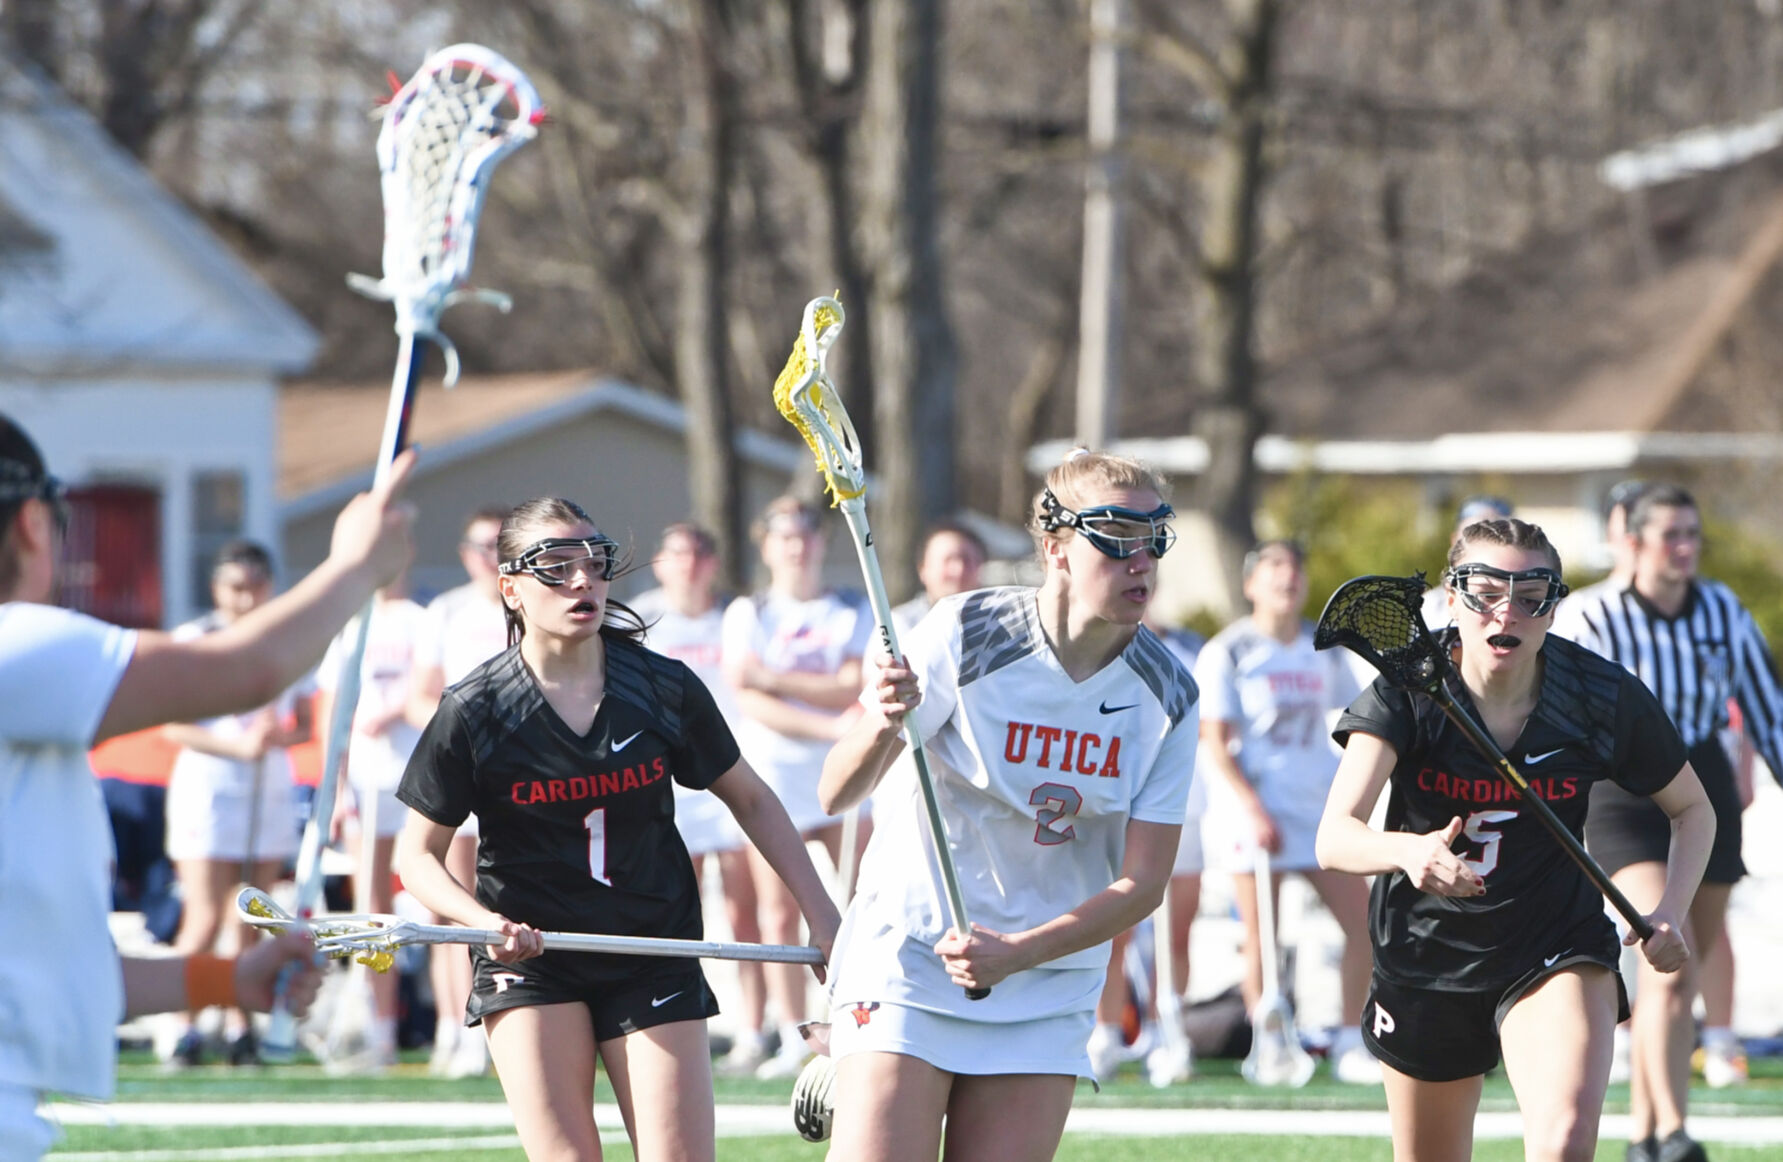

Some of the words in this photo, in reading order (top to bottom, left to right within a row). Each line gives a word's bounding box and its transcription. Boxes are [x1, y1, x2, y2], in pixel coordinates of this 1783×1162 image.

[1004, 721, 1122, 778] UTICA
[511, 757, 665, 806] CARDINALS
[1029, 782, 1083, 846] 2
[1457, 809, 1519, 877] 5
[583, 807, 613, 888] 1
[1373, 1001, 1396, 1040] P
